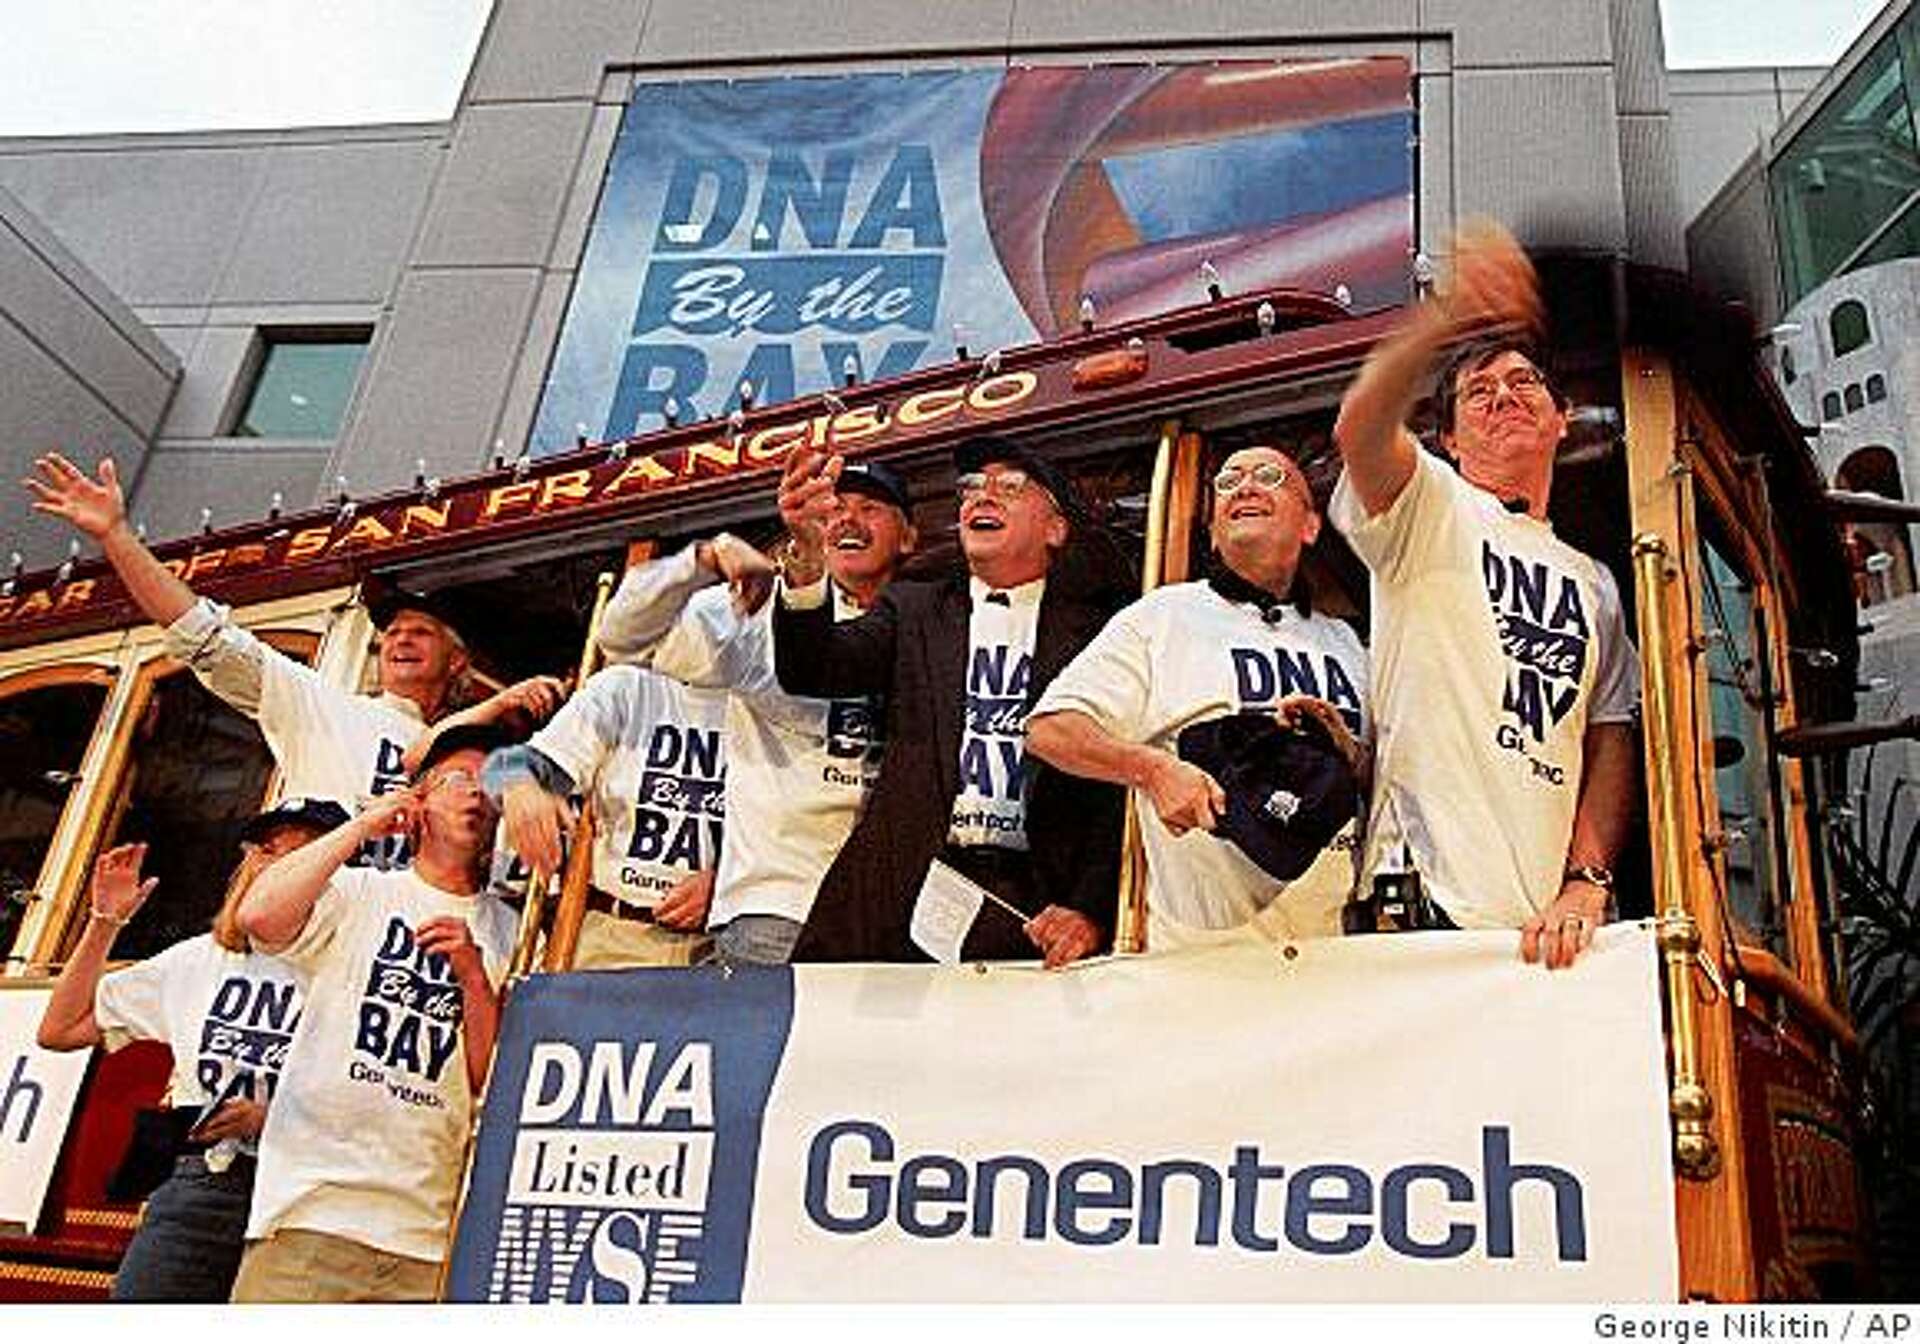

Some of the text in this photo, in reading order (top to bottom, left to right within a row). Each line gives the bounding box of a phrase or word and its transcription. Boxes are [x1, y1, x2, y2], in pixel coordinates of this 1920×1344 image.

[653, 144, 947, 252] DNA
[671, 265, 912, 337] By the
[284, 499, 453, 564] SAN
[482, 371, 1038, 521] FRANCISCO
[1482, 539, 1591, 641] DNA
[969, 644, 1035, 697] NA
[1231, 648, 1361, 712] DNA
[646, 724, 728, 779] DN
[959, 738, 1025, 801] AY
[208, 978, 305, 1034] DN
[354, 1002, 458, 1083] BAY
[519, 1041, 715, 1126] DNA
[529, 1141, 689, 1199] Listed
[804, 1120, 1587, 1262] Genentech
[489, 1207, 704, 1304] NYSE
